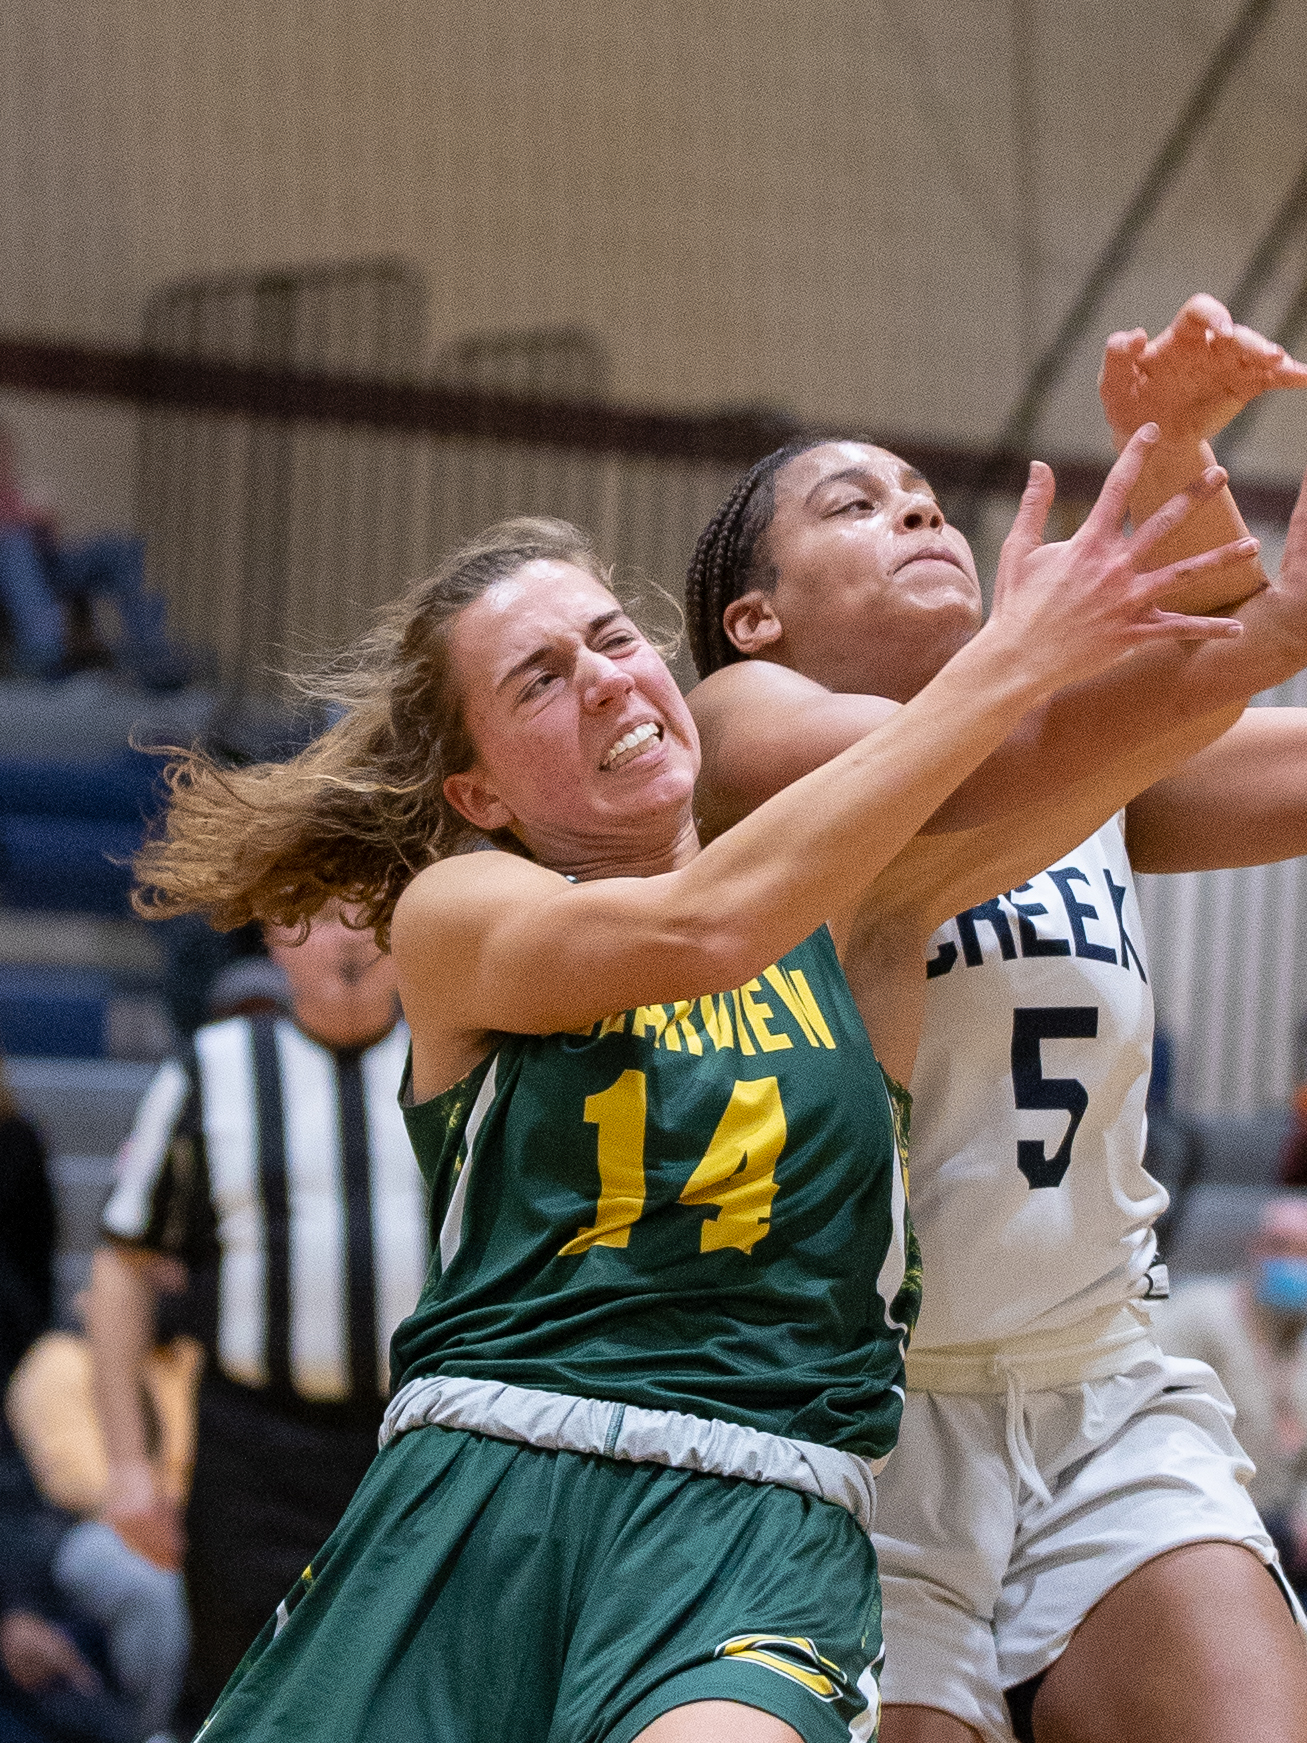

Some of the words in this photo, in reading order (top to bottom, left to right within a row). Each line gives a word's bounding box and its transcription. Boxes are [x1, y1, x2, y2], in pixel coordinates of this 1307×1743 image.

[600, 963, 837, 1057] ARVIEW
[1011, 1006, 1099, 1190] 5
[558, 1068, 788, 1256] 14
